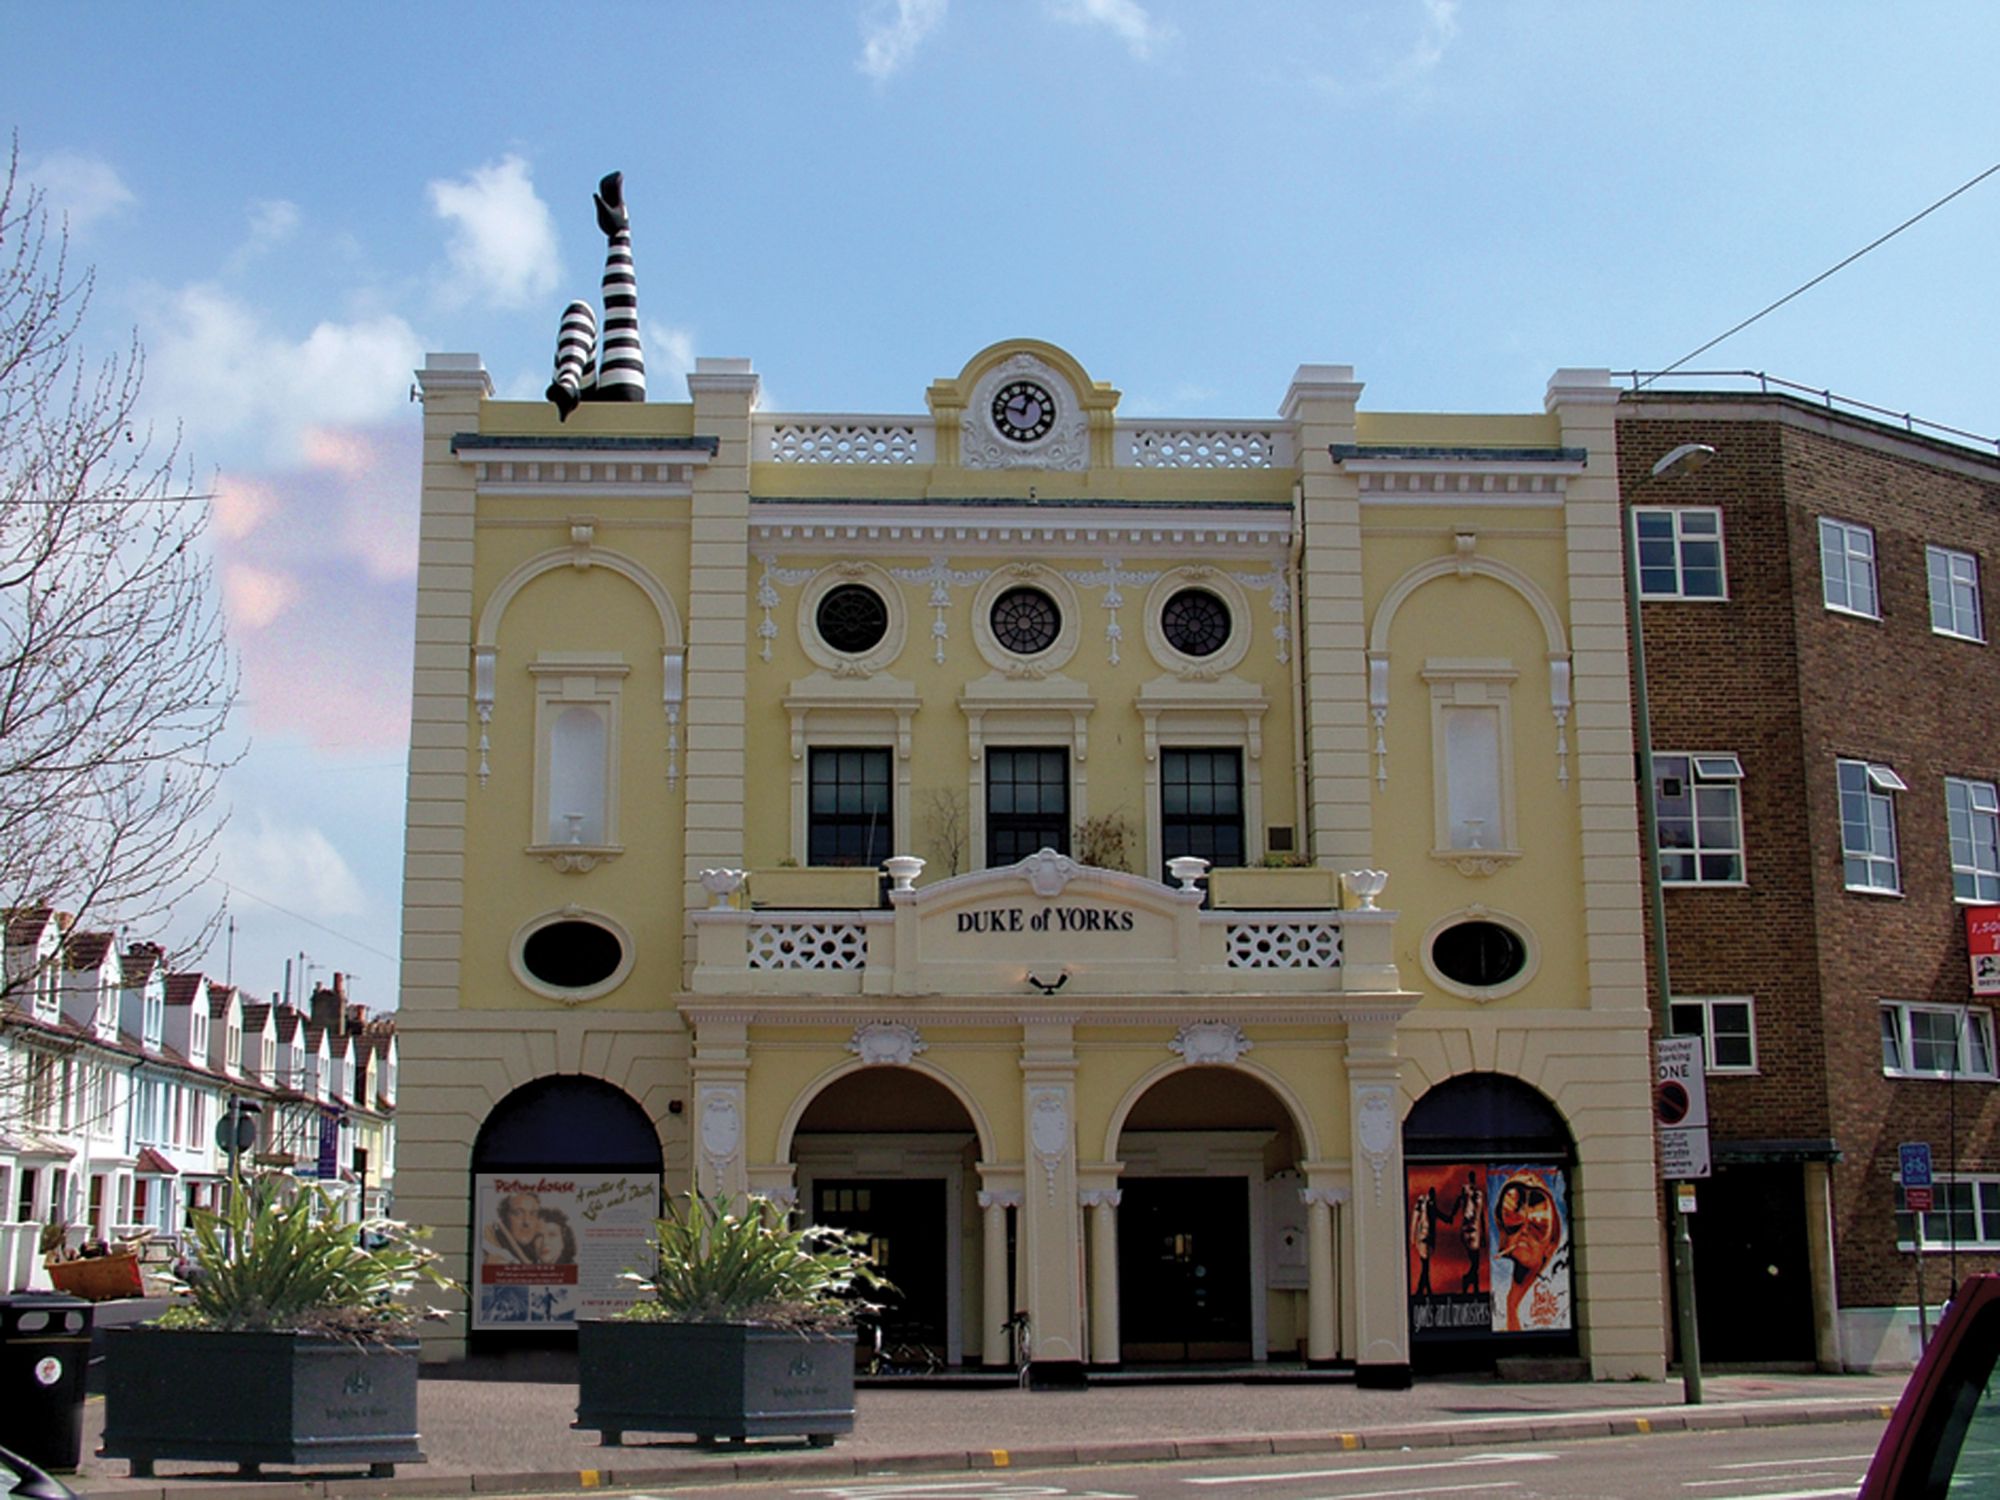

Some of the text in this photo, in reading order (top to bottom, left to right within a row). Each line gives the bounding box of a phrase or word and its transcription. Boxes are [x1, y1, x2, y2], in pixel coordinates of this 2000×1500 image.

[957, 907, 1134, 932] DUKE of YORKS
